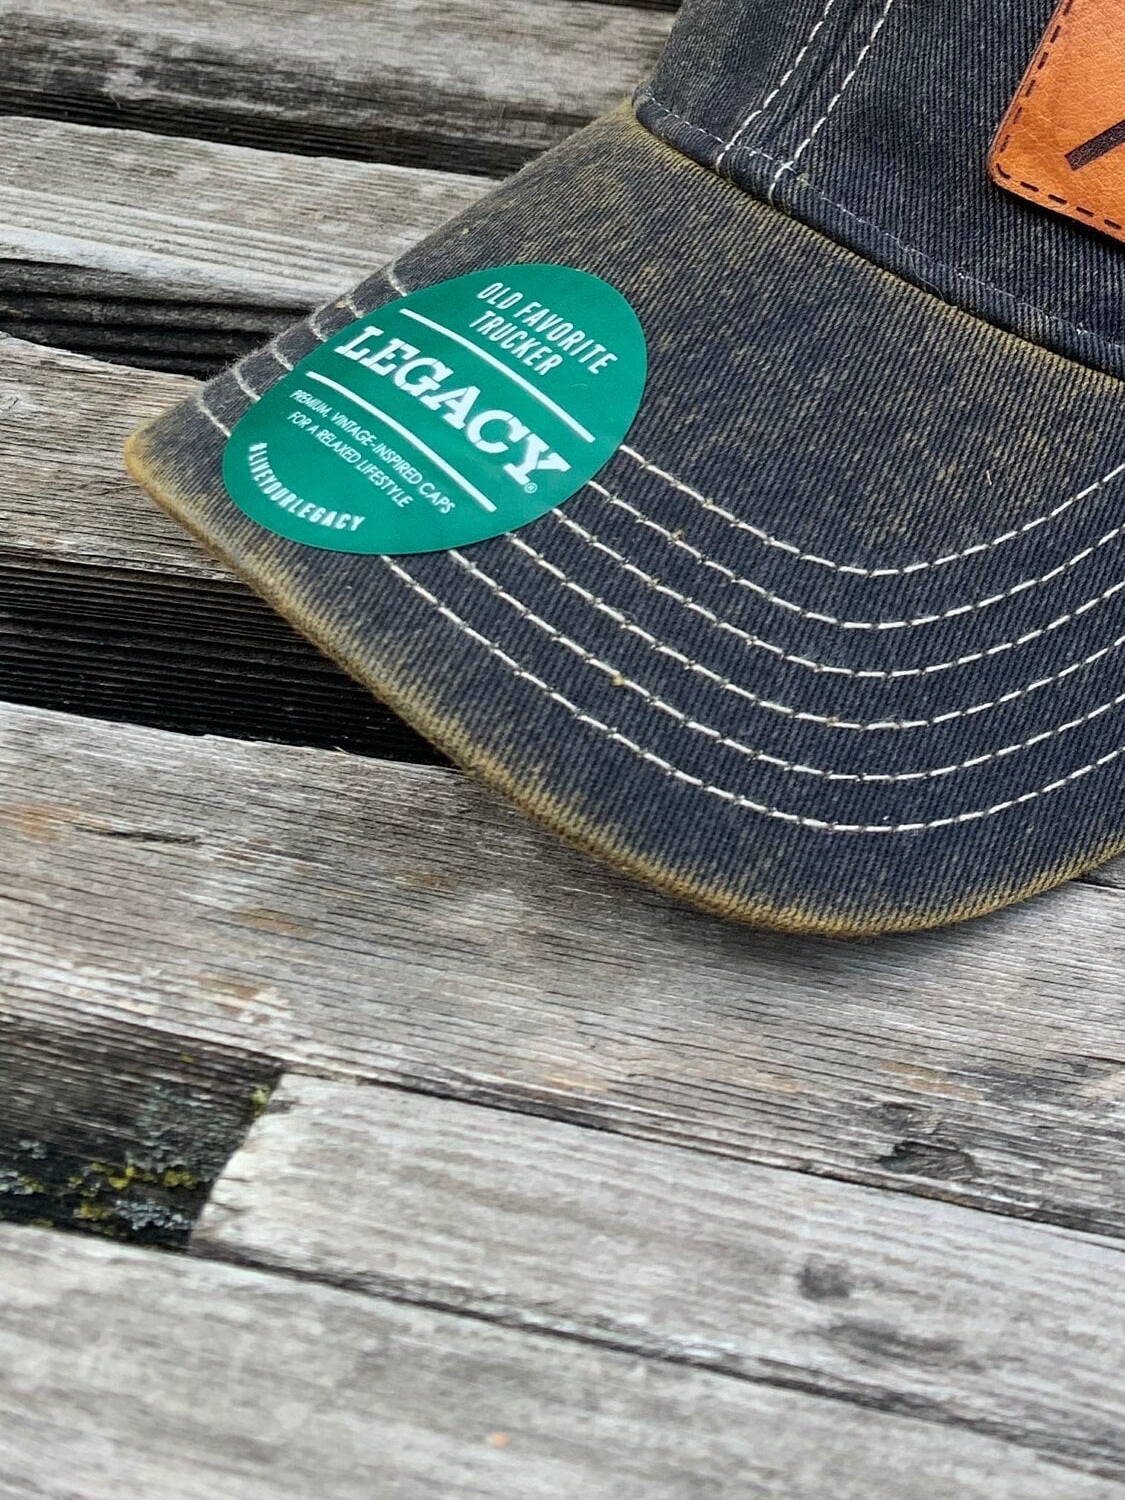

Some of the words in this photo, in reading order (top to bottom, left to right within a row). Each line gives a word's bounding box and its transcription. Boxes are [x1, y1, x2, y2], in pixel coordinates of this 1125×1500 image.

[469, 310, 564, 376] TRUCKER
[476, 282, 524, 310] OLD
[513, 301, 619, 375] FAVORITE
[289, 389, 333, 418] PREMIUM,
[330, 411, 423, 485] VINTAGE-INSPIRED
[418, 482, 456, 514] CAPS
[334, 325, 572, 489] LEGACY
[287, 411, 313, 430] FOR
[306, 424, 321, 435] A
[315, 428, 362, 464] RELAXED
[355, 459, 414, 508] LIFESTYLE
